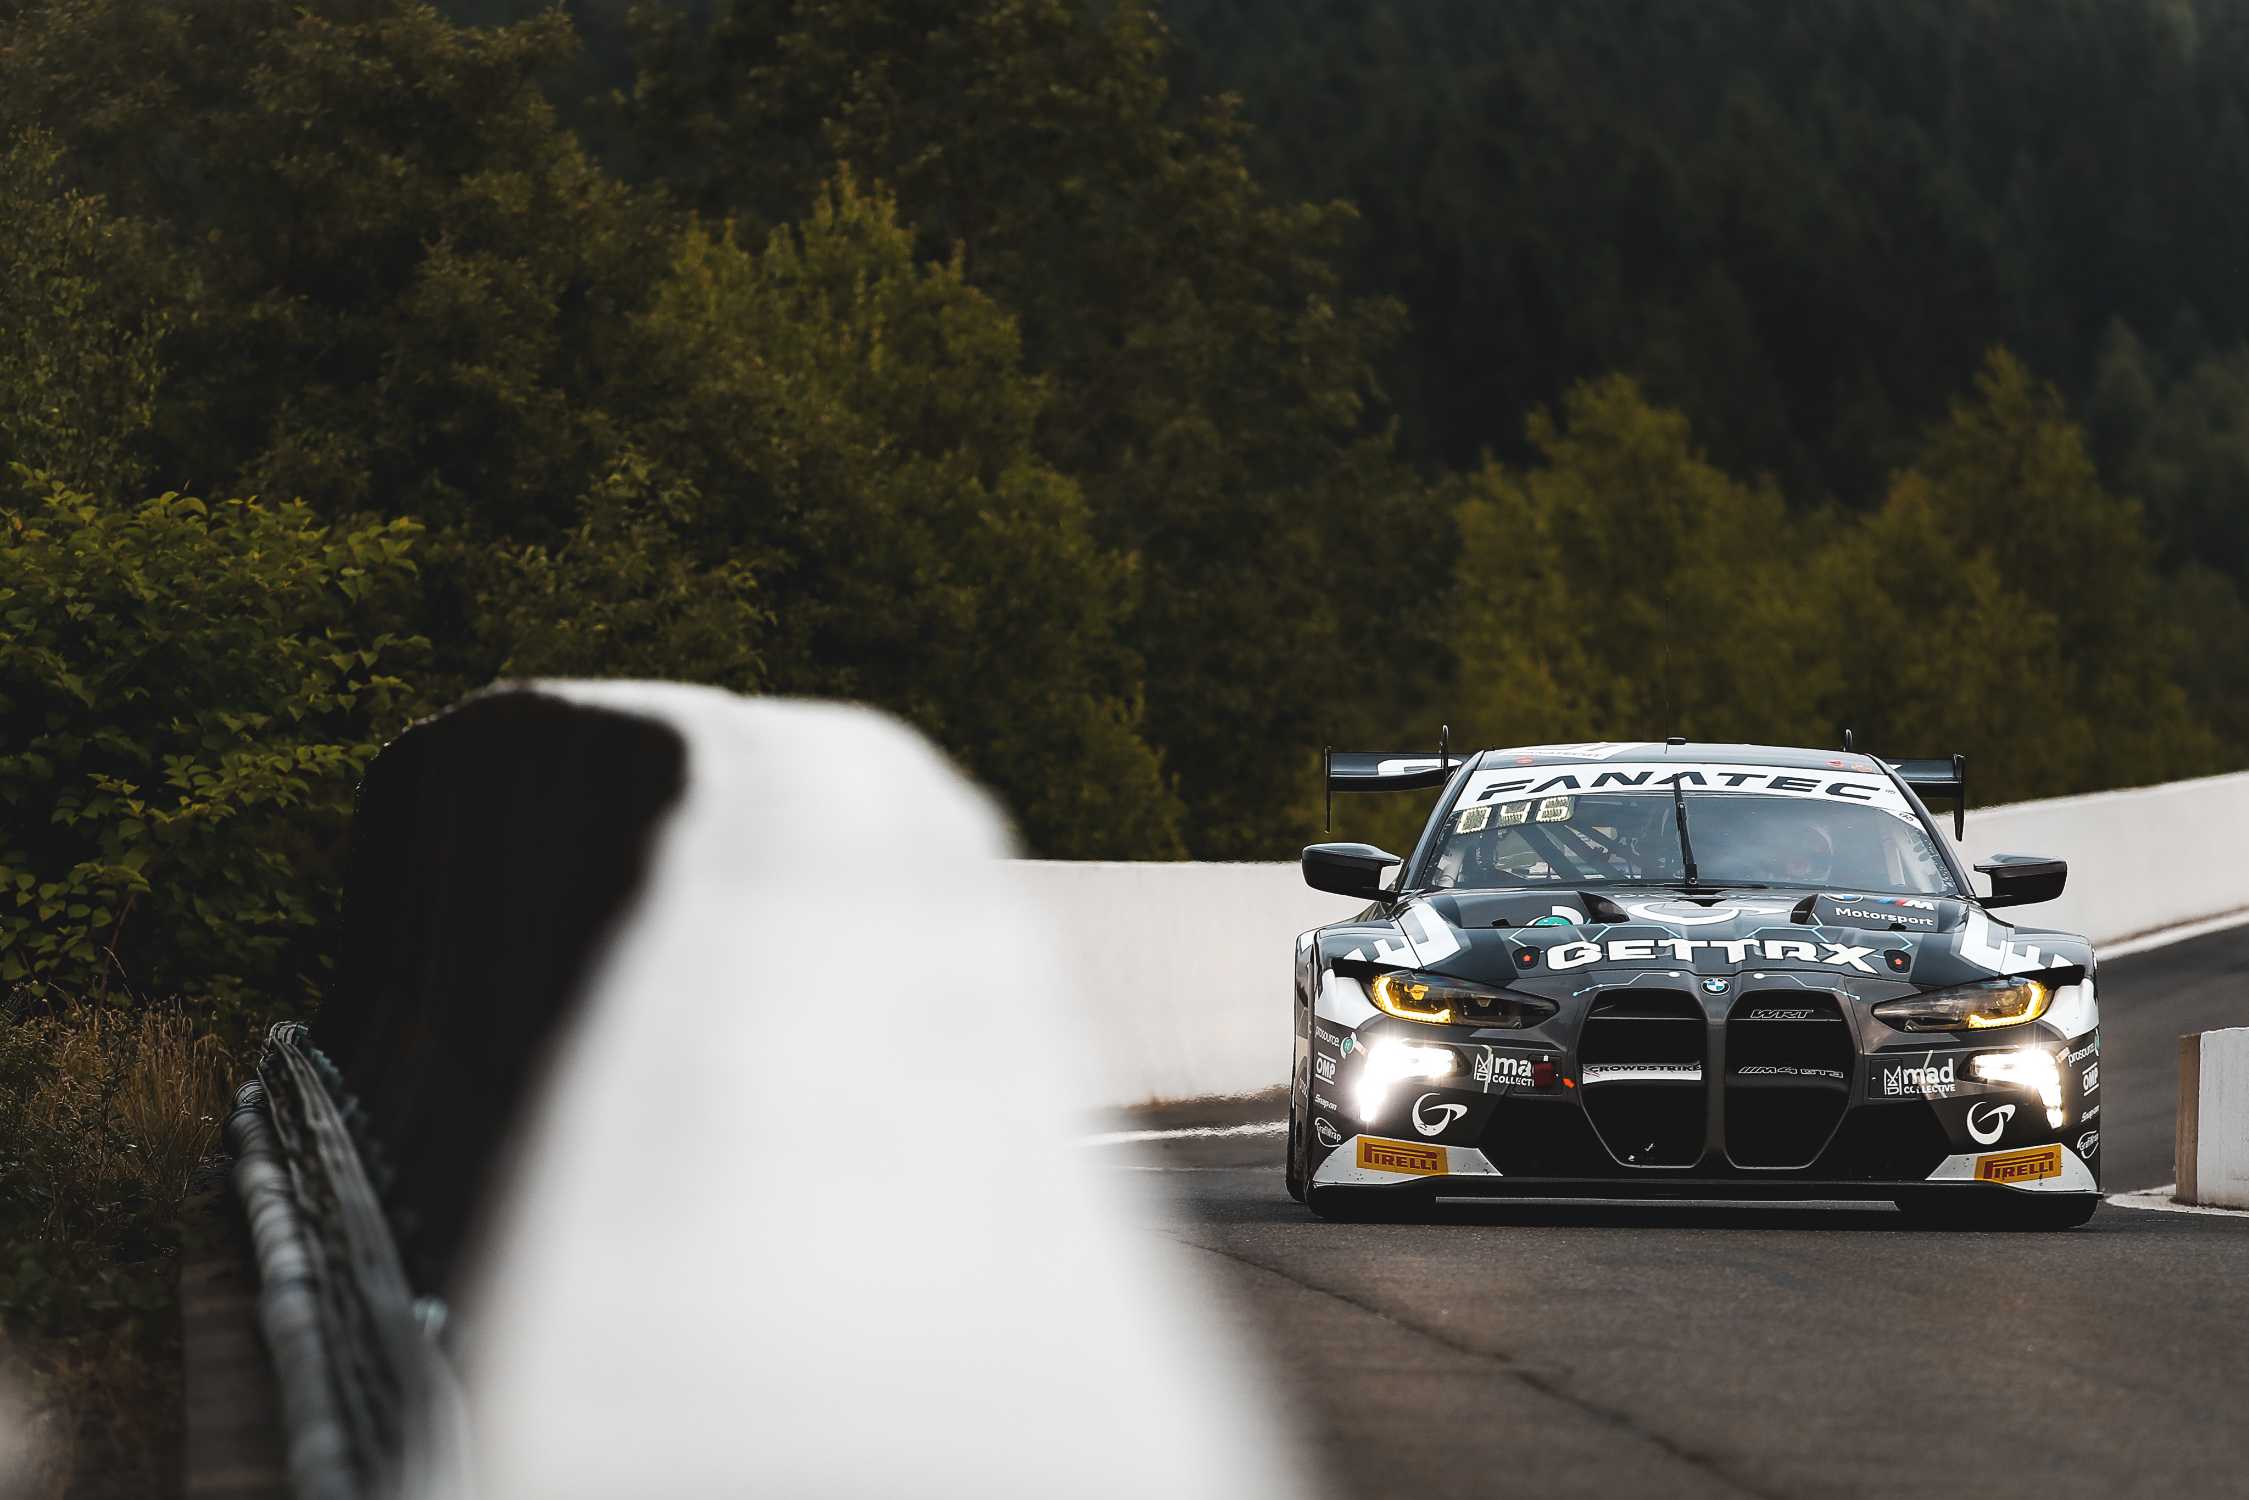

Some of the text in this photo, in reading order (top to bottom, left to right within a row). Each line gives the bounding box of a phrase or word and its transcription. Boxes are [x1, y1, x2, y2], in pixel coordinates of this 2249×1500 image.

[1476, 770, 1881, 802] FANATEC
[1456, 796, 1569, 834] 046
[1834, 907, 1934, 926] Motorsport
[1316, 1057, 1336, 1079] OMP
[1494, 1057, 1536, 1077] ma
[1589, 1063, 1704, 1073] CROWDSTRIKE
[1902, 1058, 1955, 1085] mad
[1363, 1142, 1438, 1171] PIRELLI
[1983, 1151, 2055, 1180] PIRELLI
